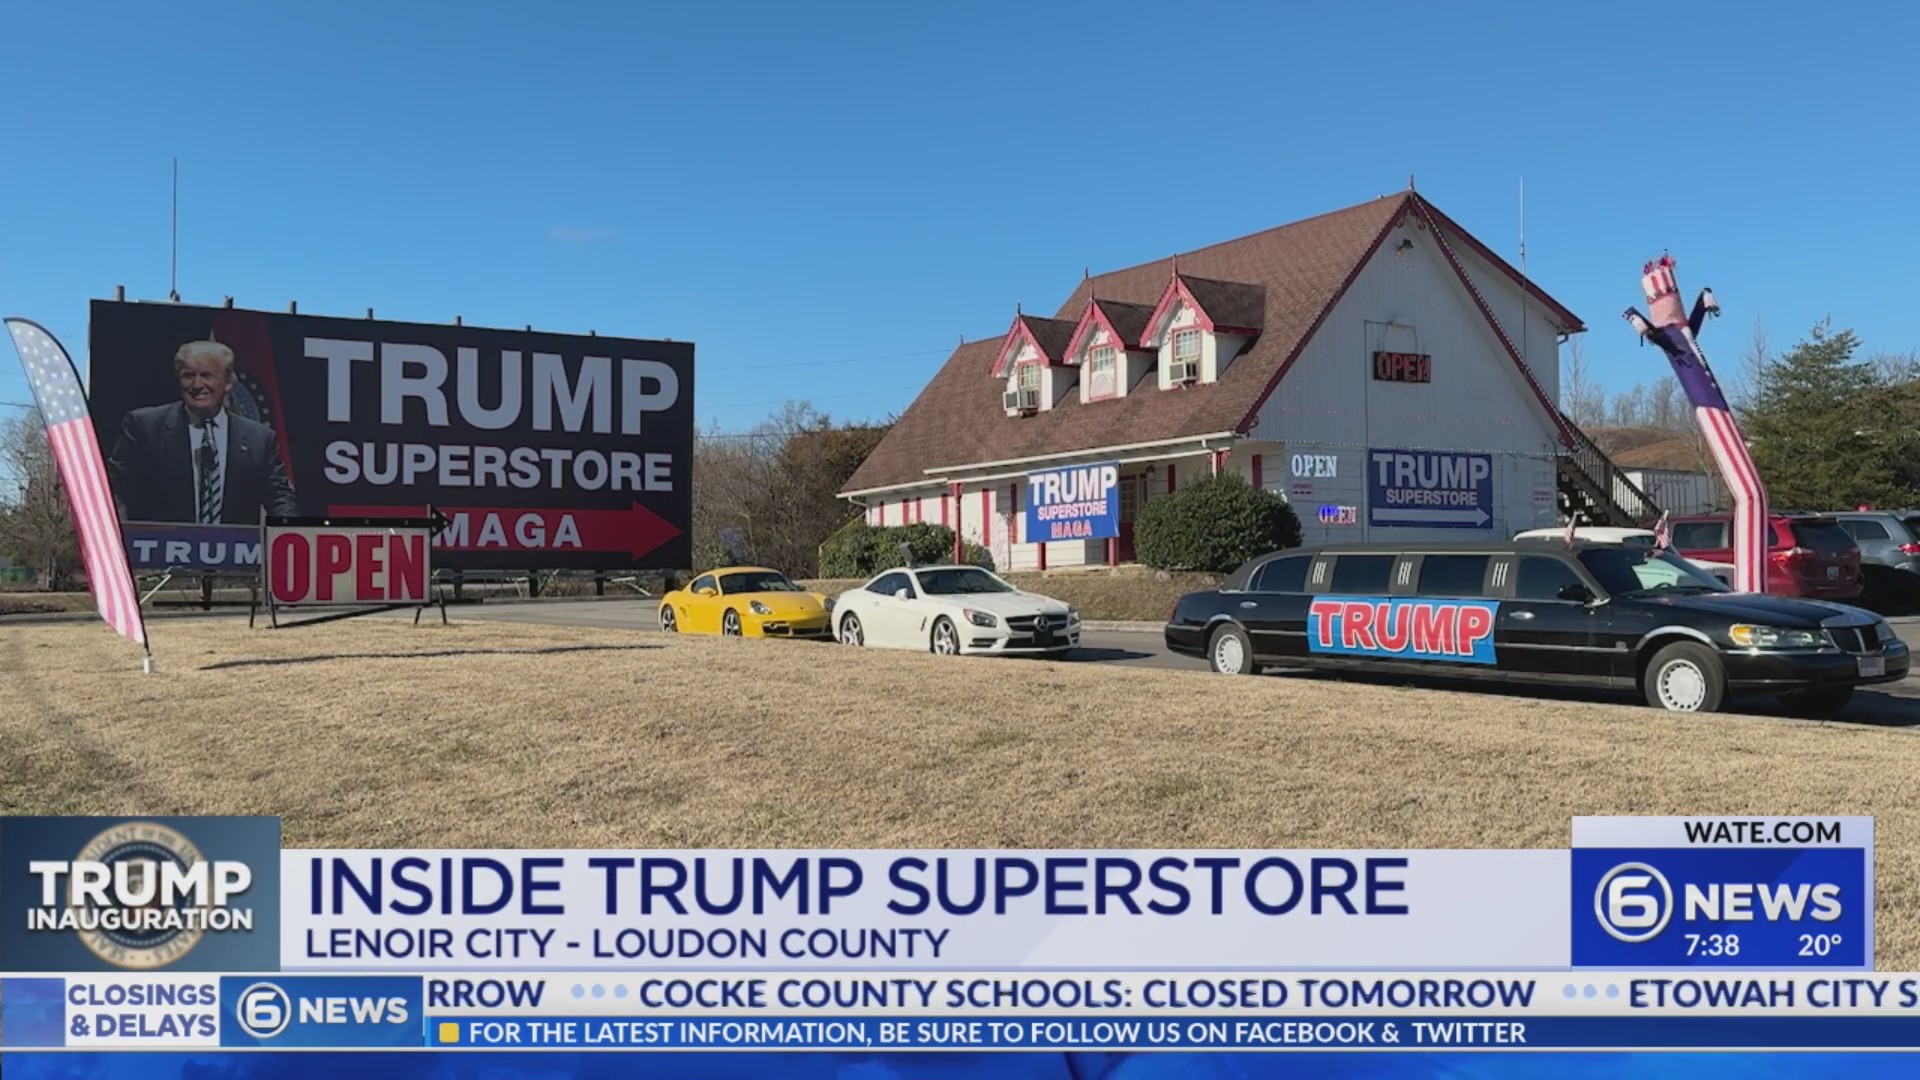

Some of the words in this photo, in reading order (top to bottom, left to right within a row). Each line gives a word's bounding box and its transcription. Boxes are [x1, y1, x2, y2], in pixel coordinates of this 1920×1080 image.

[1376, 352, 1431, 382] OPEN
[303, 337, 680, 436] TRUMP
[323, 440, 673, 492] SUPERSTORE
[1291, 454, 1338, 477] OPEN
[1371, 453, 1490, 490] TRUMP
[1028, 466, 1117, 506] TRUMP
[1386, 488, 1478, 506] SUPERSTORE
[1037, 500, 1108, 521] SUPERSTORE
[1318, 504, 1357, 524] OPEN
[432, 512, 583, 548] MAGA
[1051, 519, 1093, 539] MAGA
[133, 539, 263, 565] TRUM
[270, 532, 425, 603] OPEN
[1311, 601, 1493, 656] TRUMP
